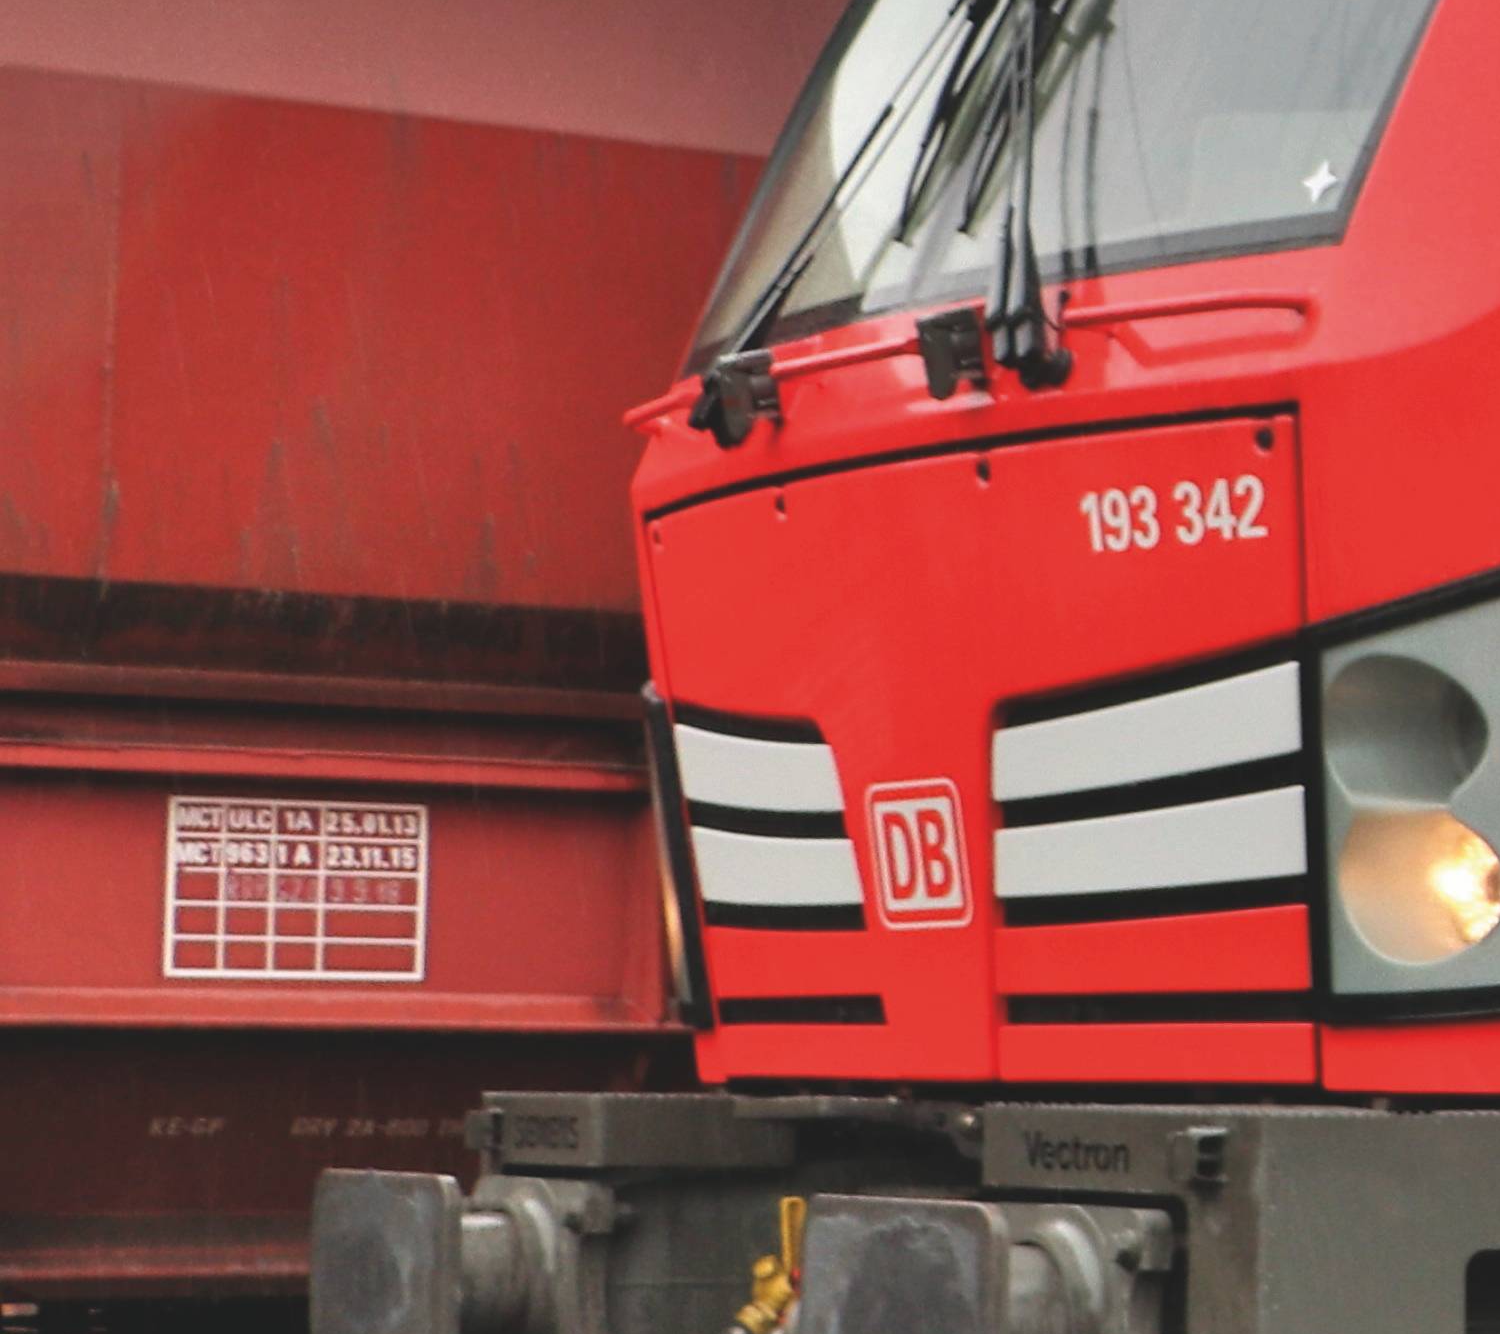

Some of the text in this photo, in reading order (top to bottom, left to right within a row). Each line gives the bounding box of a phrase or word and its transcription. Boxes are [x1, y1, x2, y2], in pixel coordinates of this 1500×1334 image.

[1079, 473, 1269, 553] 193 342
[175, 805, 223, 830] MCT
[174, 839, 222, 865] MCT
[1023, 1129, 1131, 1172] Vectron
